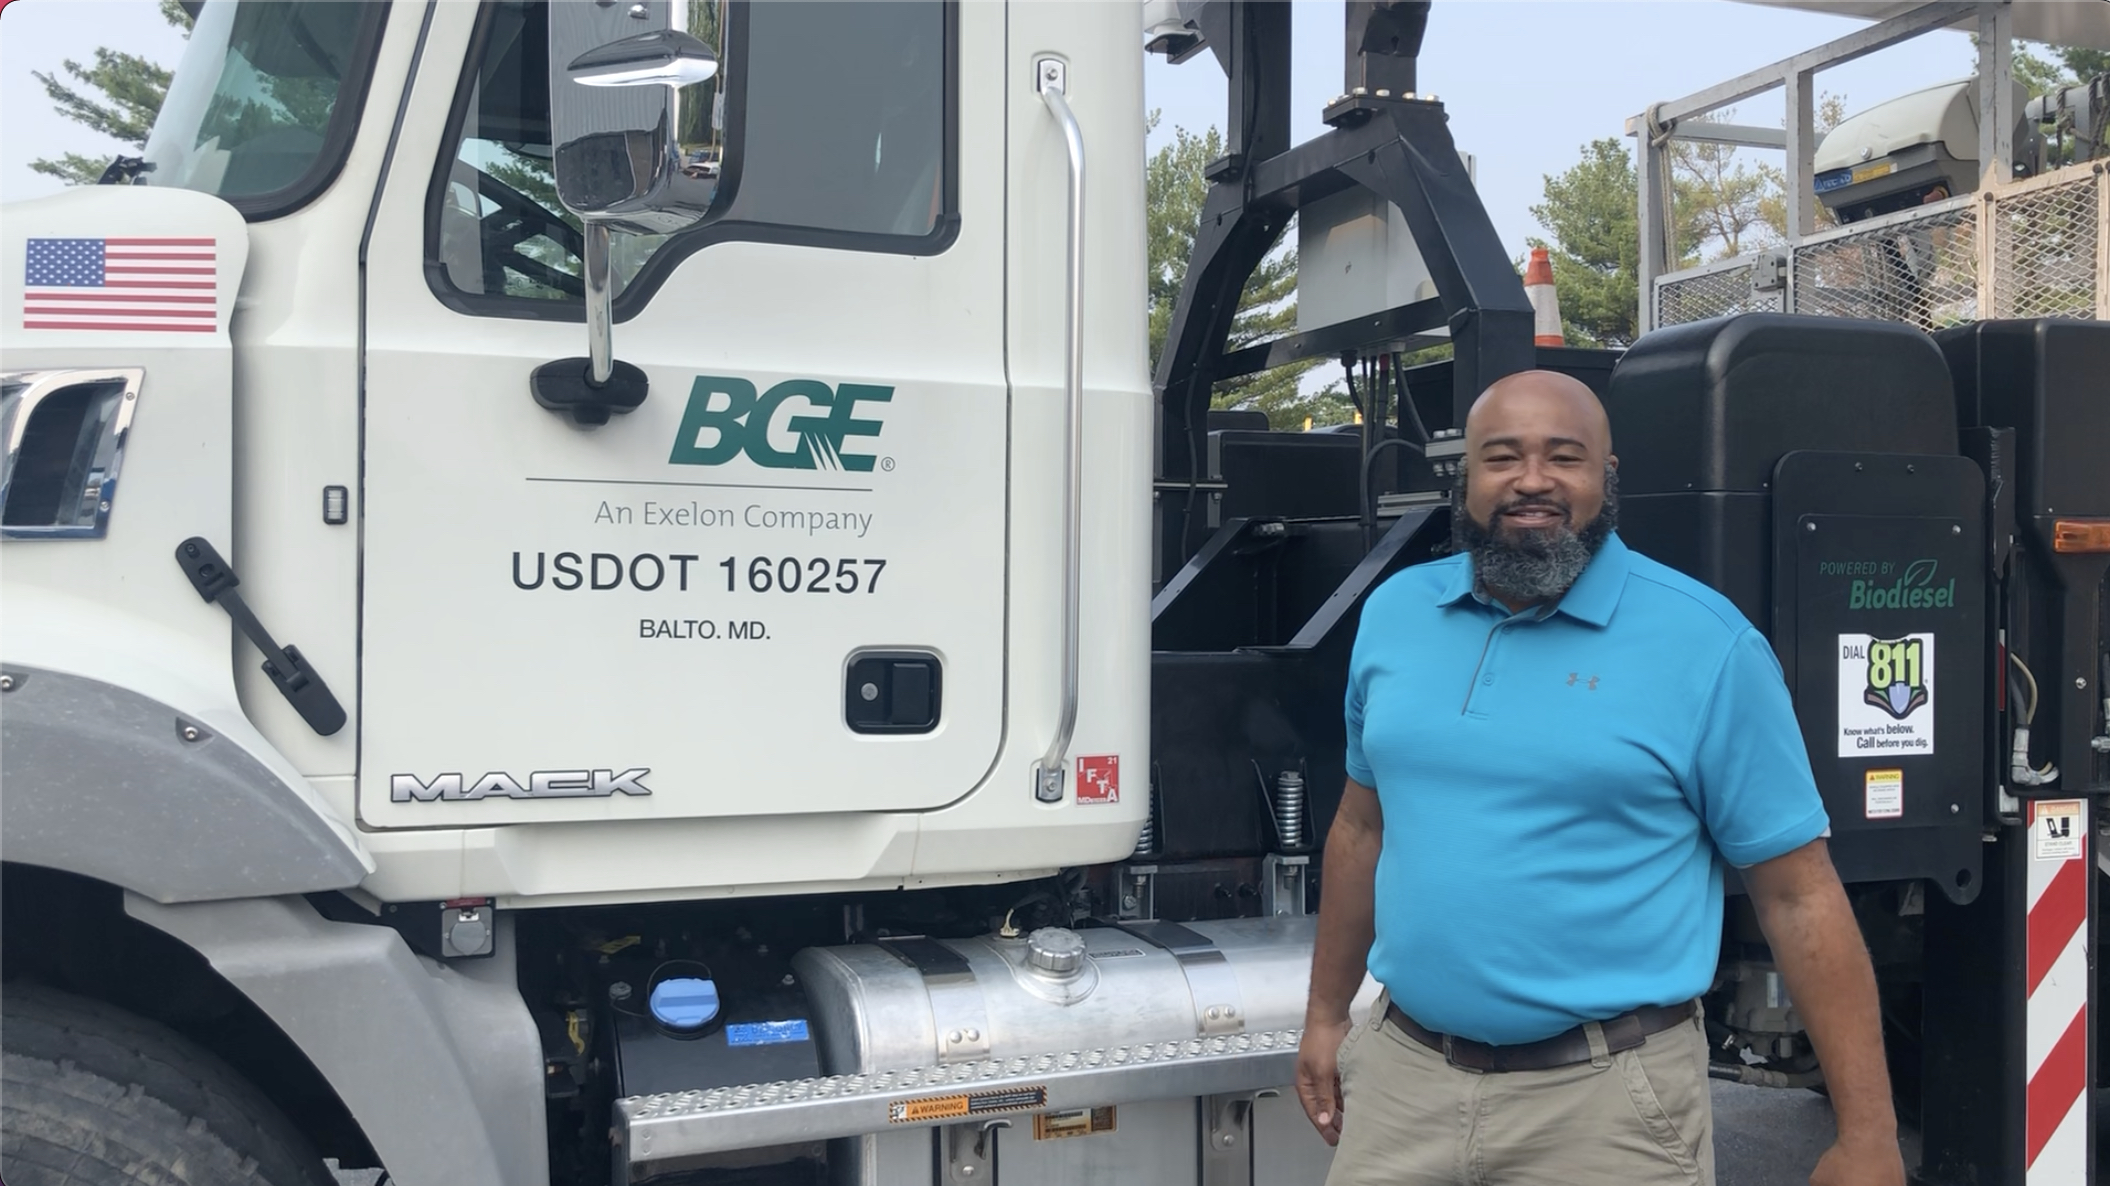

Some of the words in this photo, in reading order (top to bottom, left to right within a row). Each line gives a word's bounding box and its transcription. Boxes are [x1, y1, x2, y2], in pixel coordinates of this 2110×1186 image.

[668, 375, 895, 472] BGE
[594, 501, 633, 524] An
[644, 501, 735, 527] Exelon
[744, 504, 873, 538] Company
[512, 551, 699, 592] USDOT
[719, 556, 887, 594] 160257
[1819, 561, 1877, 575] POWERED
[1881, 562, 1896, 575] BY
[1850, 578, 1955, 609] Biodiesel
[639, 619, 722, 640] BALTO.
[728, 621, 771, 640] MD.
[1843, 645, 1865, 659] DIAL
[1870, 641, 1920, 689] 811
[1843, 727, 1863, 736] Know
[1864, 727, 1885, 735] what's
[1886, 723, 1914, 735] below.
[1857, 736, 1875, 749] Call
[1876, 739, 1900, 748] before
[1901, 740, 1914, 749] you
[1915, 737, 1928, 748] dig.
[390, 768, 652, 802] MACK
[920, 1101, 964, 1114] WARNING
